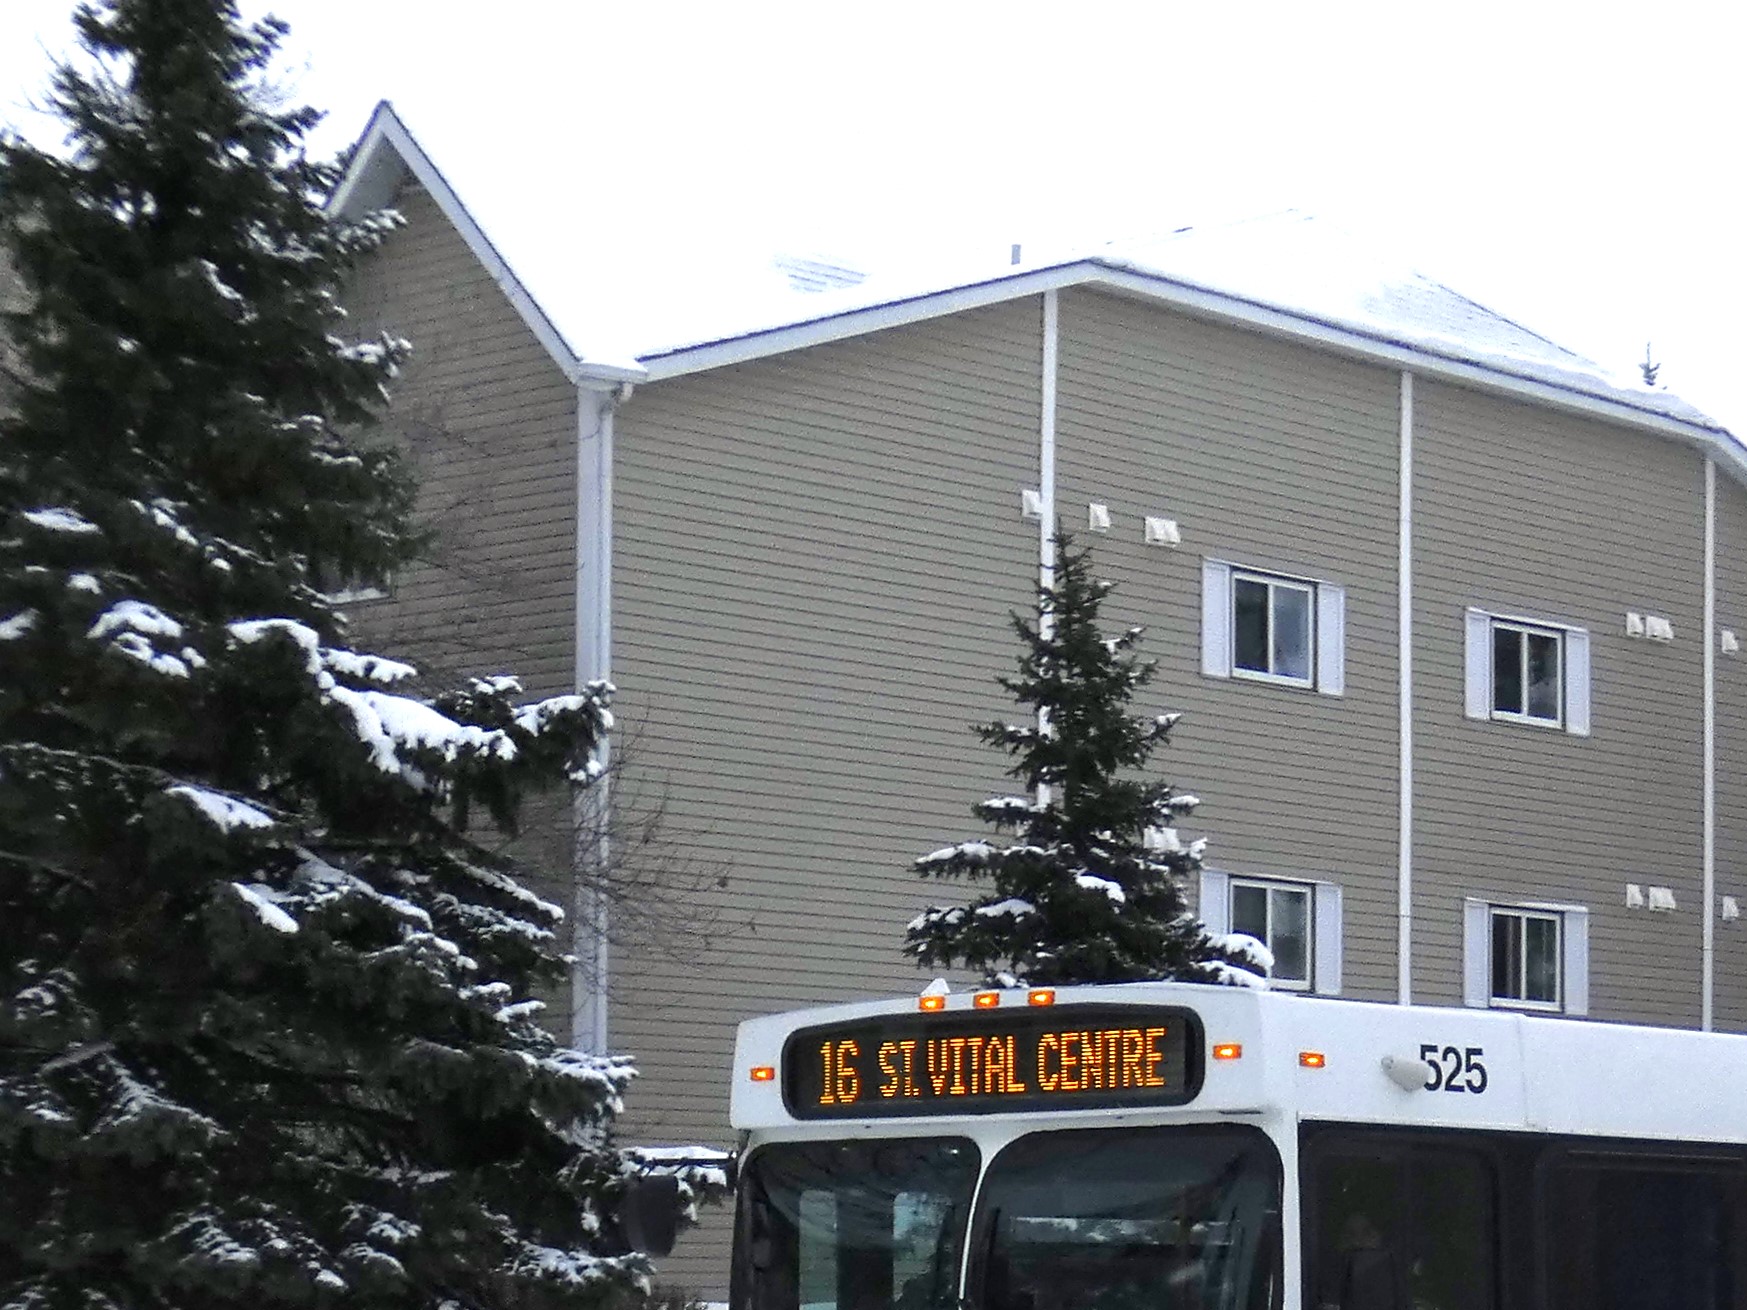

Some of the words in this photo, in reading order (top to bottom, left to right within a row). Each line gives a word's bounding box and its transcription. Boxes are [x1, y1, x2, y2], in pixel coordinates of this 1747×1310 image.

[819, 1039, 859, 1104] 16
[927, 1035, 1026, 1096] VITAL
[1037, 1027, 1167, 1092] CENTRE
[1420, 1044, 1488, 1094] 525
